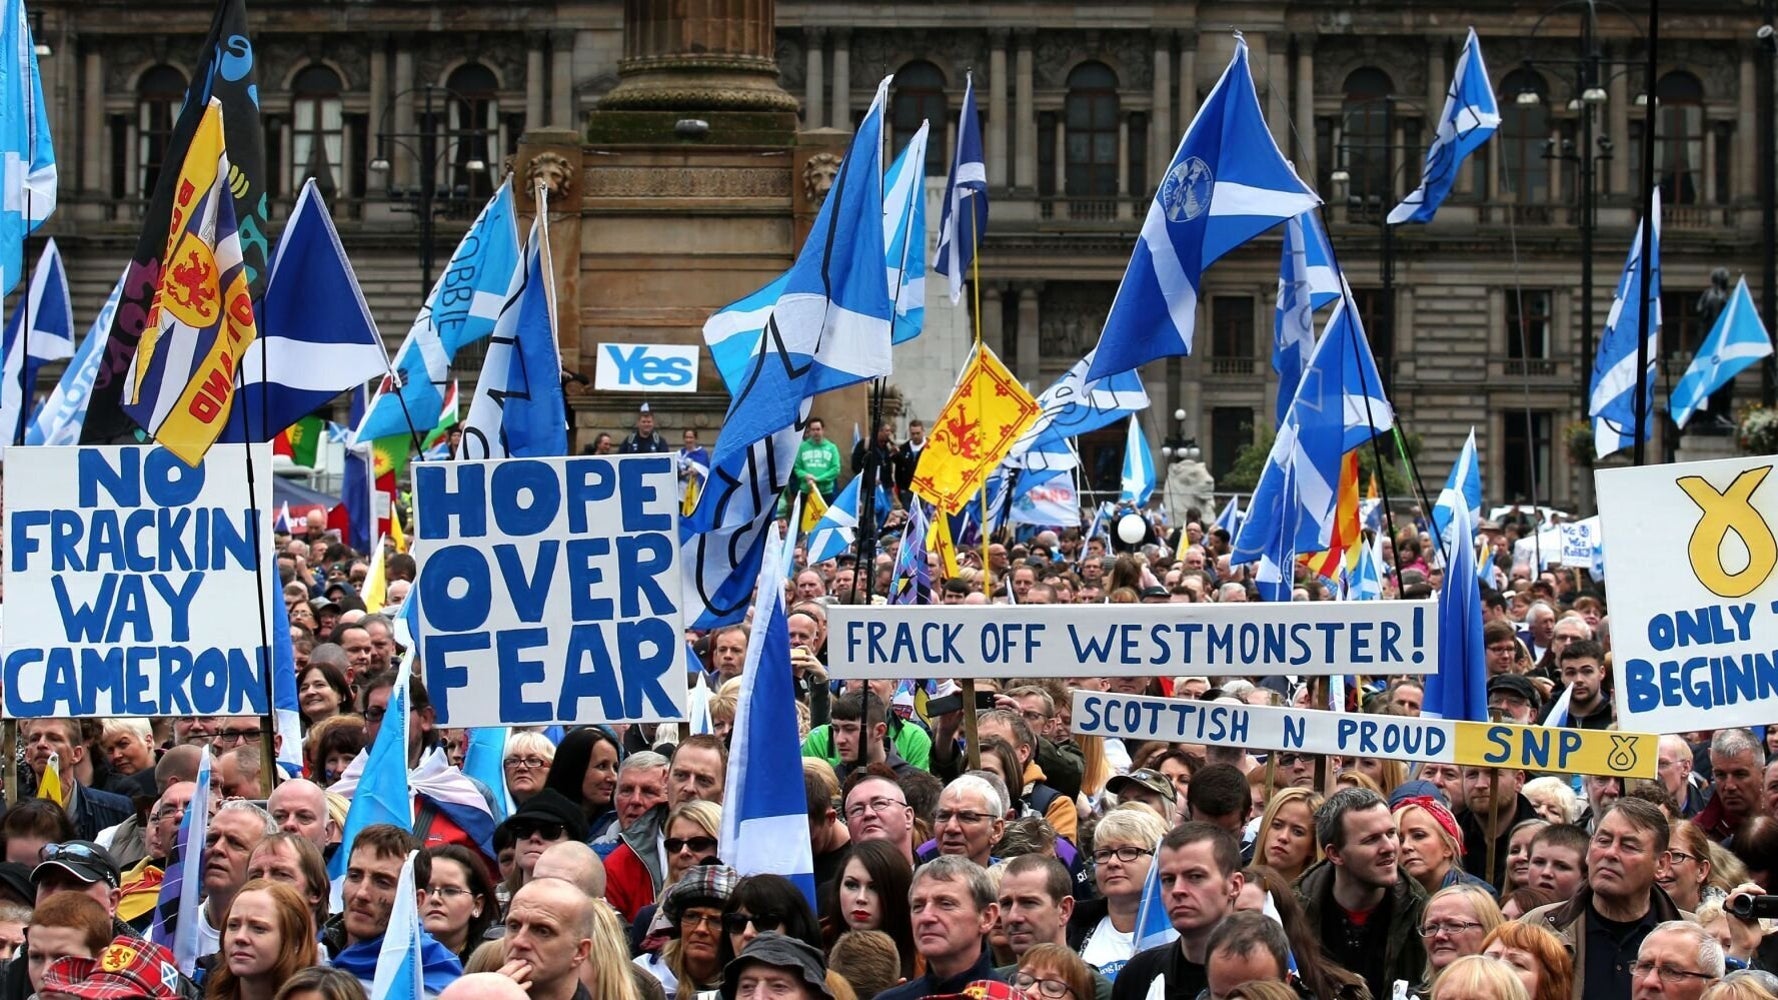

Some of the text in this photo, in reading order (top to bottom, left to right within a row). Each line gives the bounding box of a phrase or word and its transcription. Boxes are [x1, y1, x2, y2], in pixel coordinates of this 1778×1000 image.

[604, 345, 692, 386] Yes
[78, 446, 206, 507] NO
[415, 458, 672, 540] HOPE
[11, 507, 261, 572] FRACKIN
[51, 571, 205, 643] WAY
[419, 532, 677, 632] OVER
[847, 607, 1424, 666] FRACK OFF WESTMONSTER!
[1647, 603, 1756, 651] ONLY
[4, 645, 272, 717] CAMERON
[424, 617, 683, 725] FEAR
[1080, 696, 1582, 769] SCOTTISH N PROUD SNP
